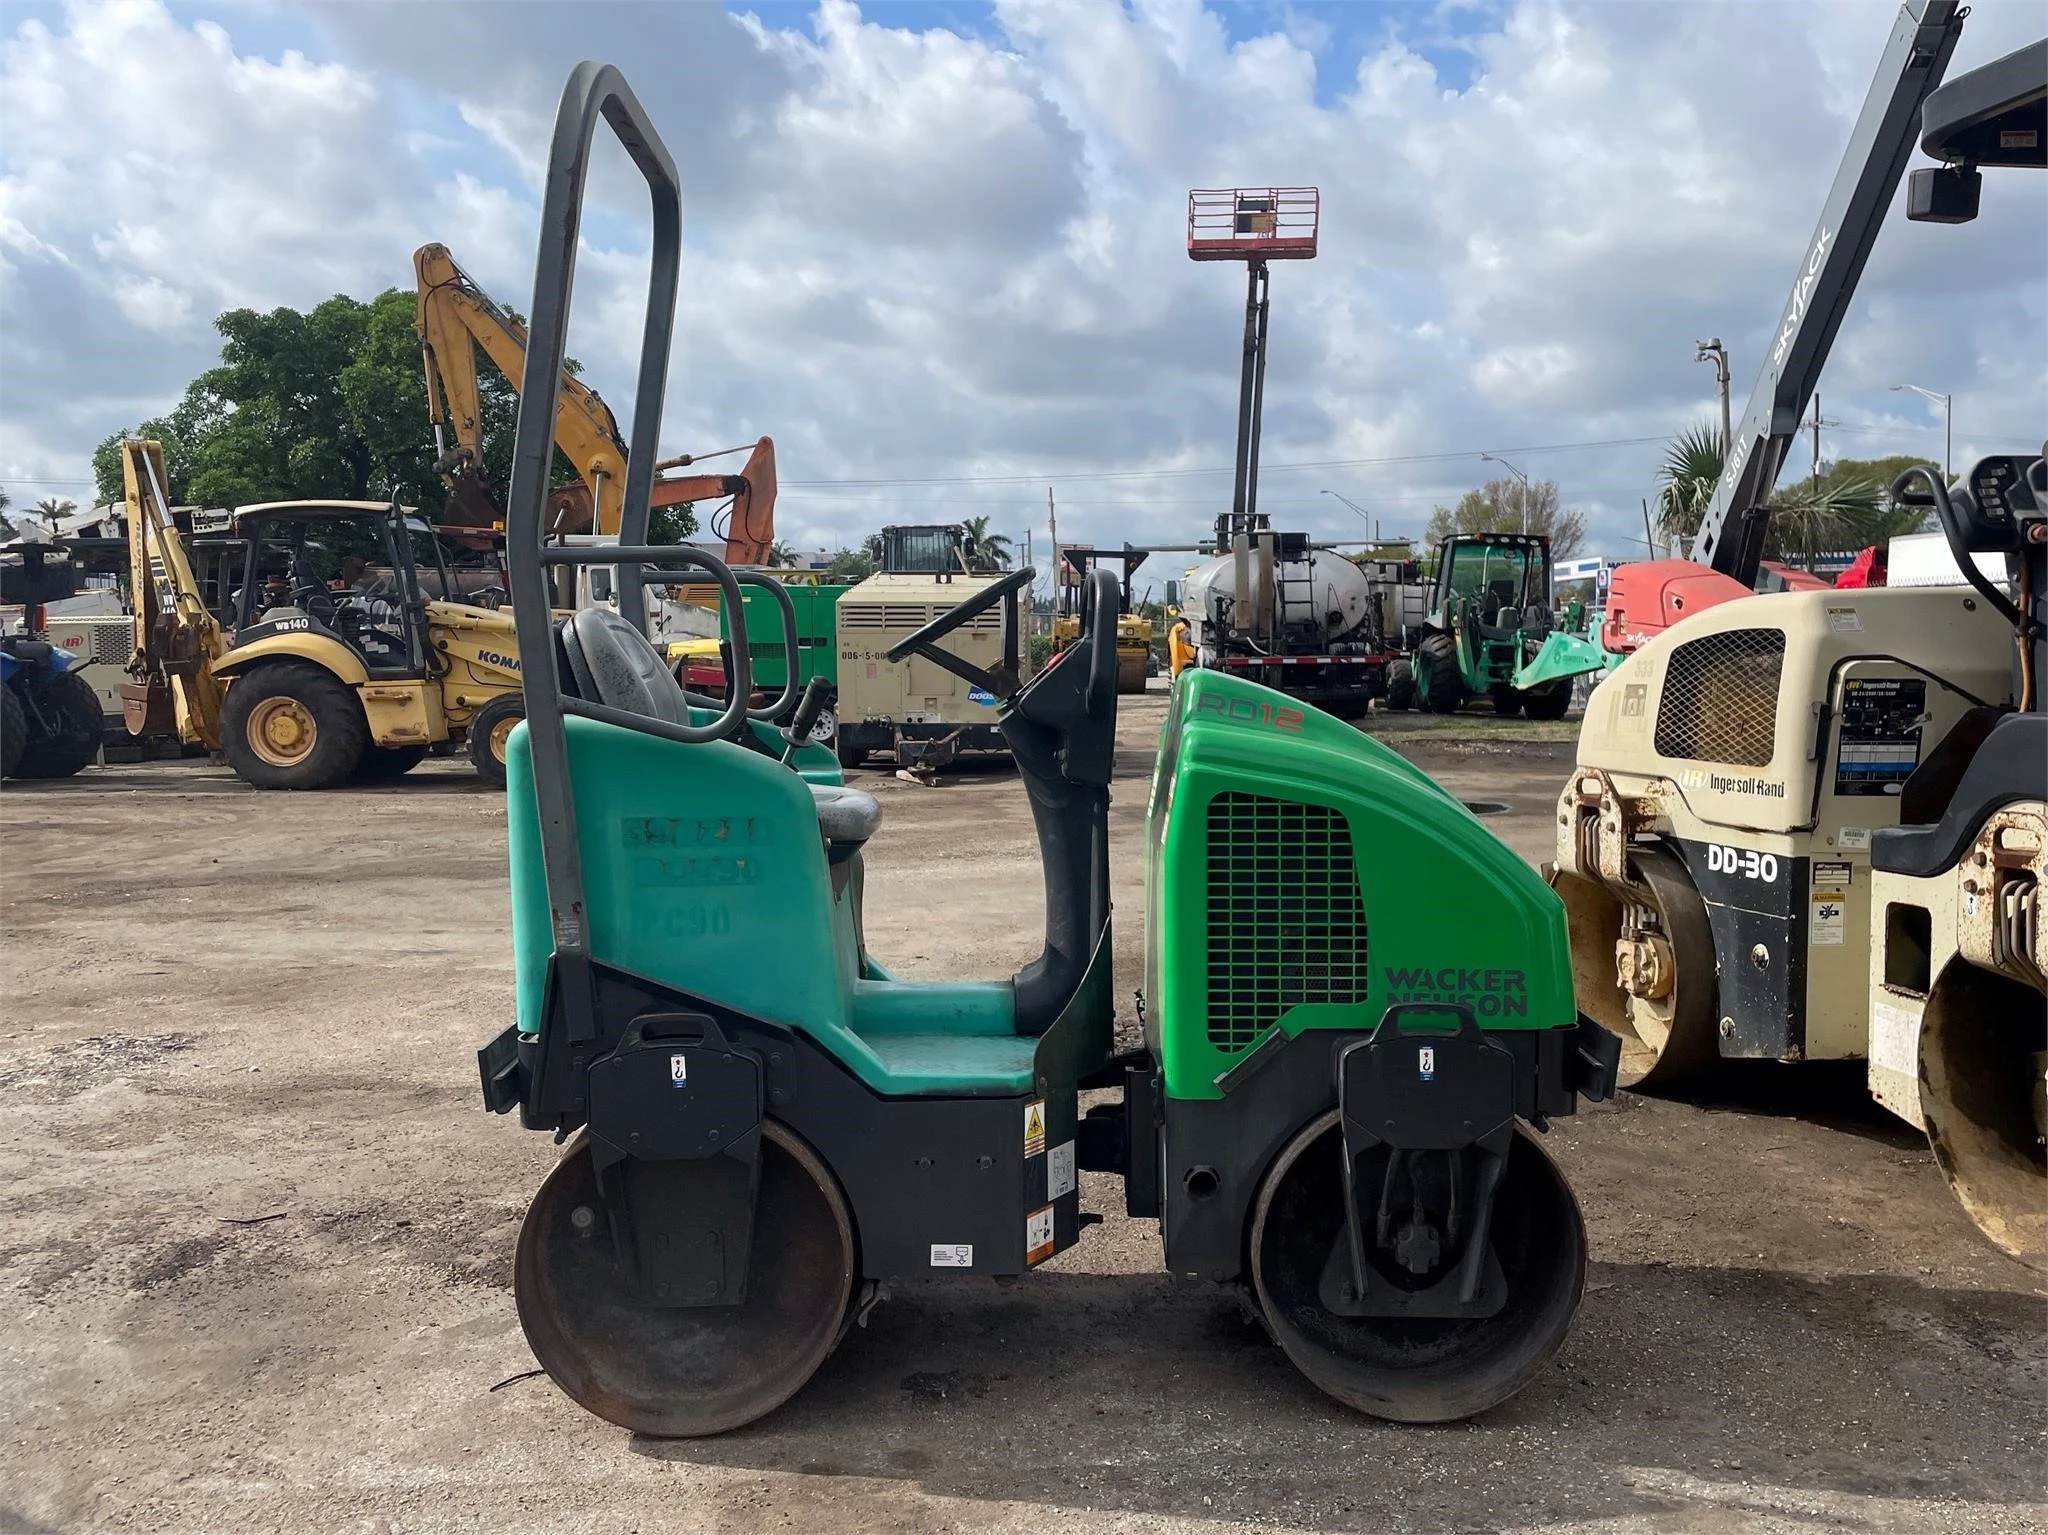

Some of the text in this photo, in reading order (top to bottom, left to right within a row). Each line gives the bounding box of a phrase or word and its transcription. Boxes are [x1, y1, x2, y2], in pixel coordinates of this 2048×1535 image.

[1773, 226, 1832, 366] SKYJACK
[1726, 433, 1747, 489] SJ61T
[1197, 692, 1305, 731] RD12
[1708, 843, 1778, 883] DD-30
[1383, 967, 1527, 992] WACKER
